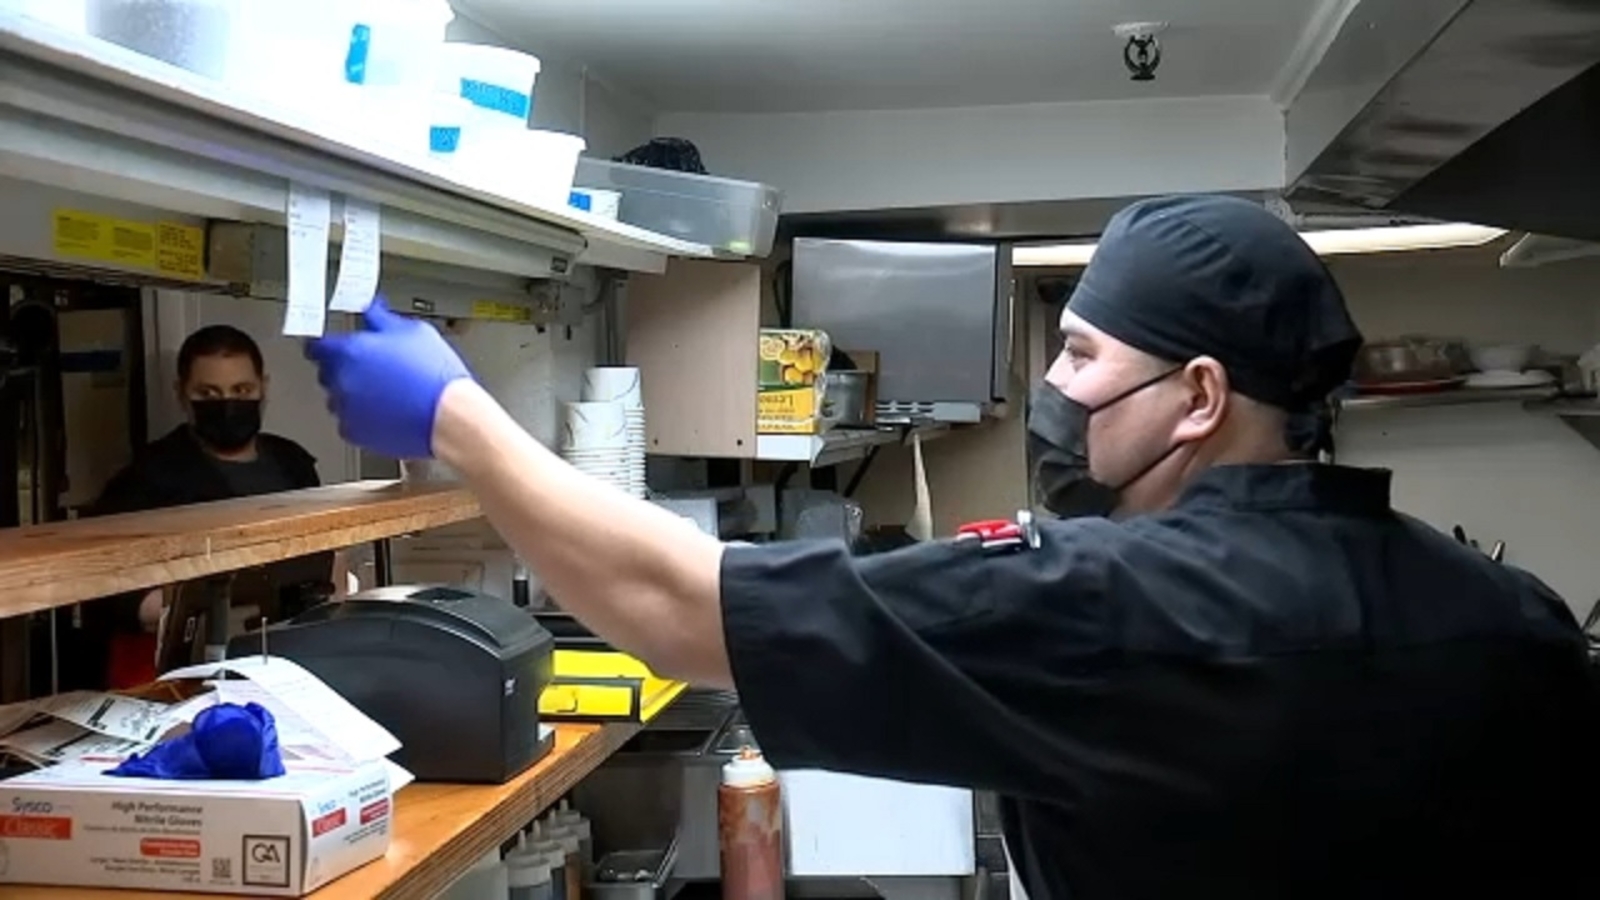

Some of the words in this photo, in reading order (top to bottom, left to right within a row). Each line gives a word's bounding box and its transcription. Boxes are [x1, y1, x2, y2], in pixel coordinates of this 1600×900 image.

[12, 797, 53, 814] Sysco
[111, 802, 136, 813] High
[138, 802, 203, 813] Performance
[134, 814, 165, 825] Nitrile
[168, 815, 203, 827] Gloves
